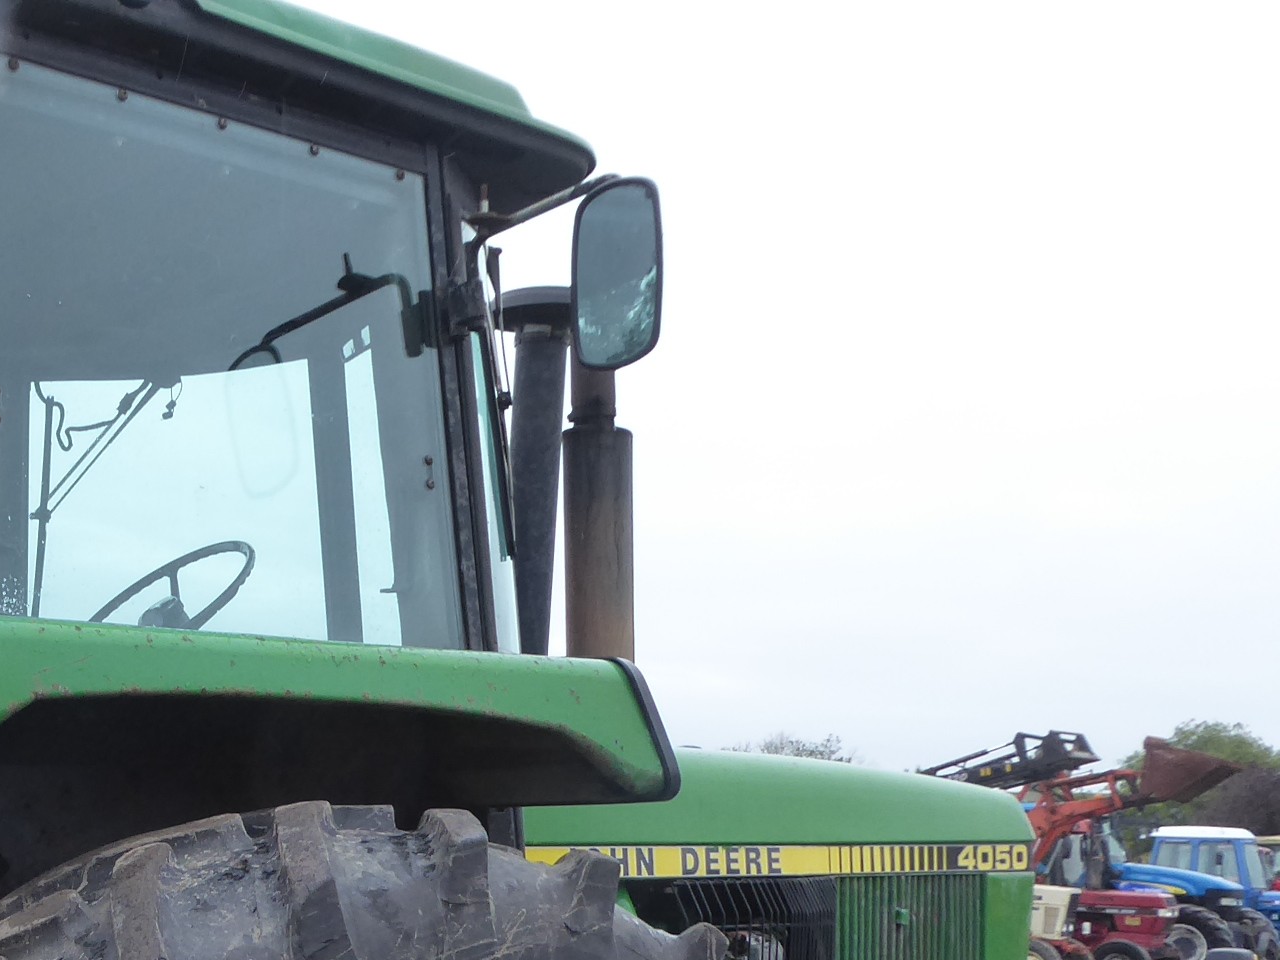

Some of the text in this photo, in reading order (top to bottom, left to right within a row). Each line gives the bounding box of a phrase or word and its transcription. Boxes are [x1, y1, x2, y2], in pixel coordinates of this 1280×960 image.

[570, 846, 782, 876] HN DEERE
[957, 844, 1028, 871] 4050
